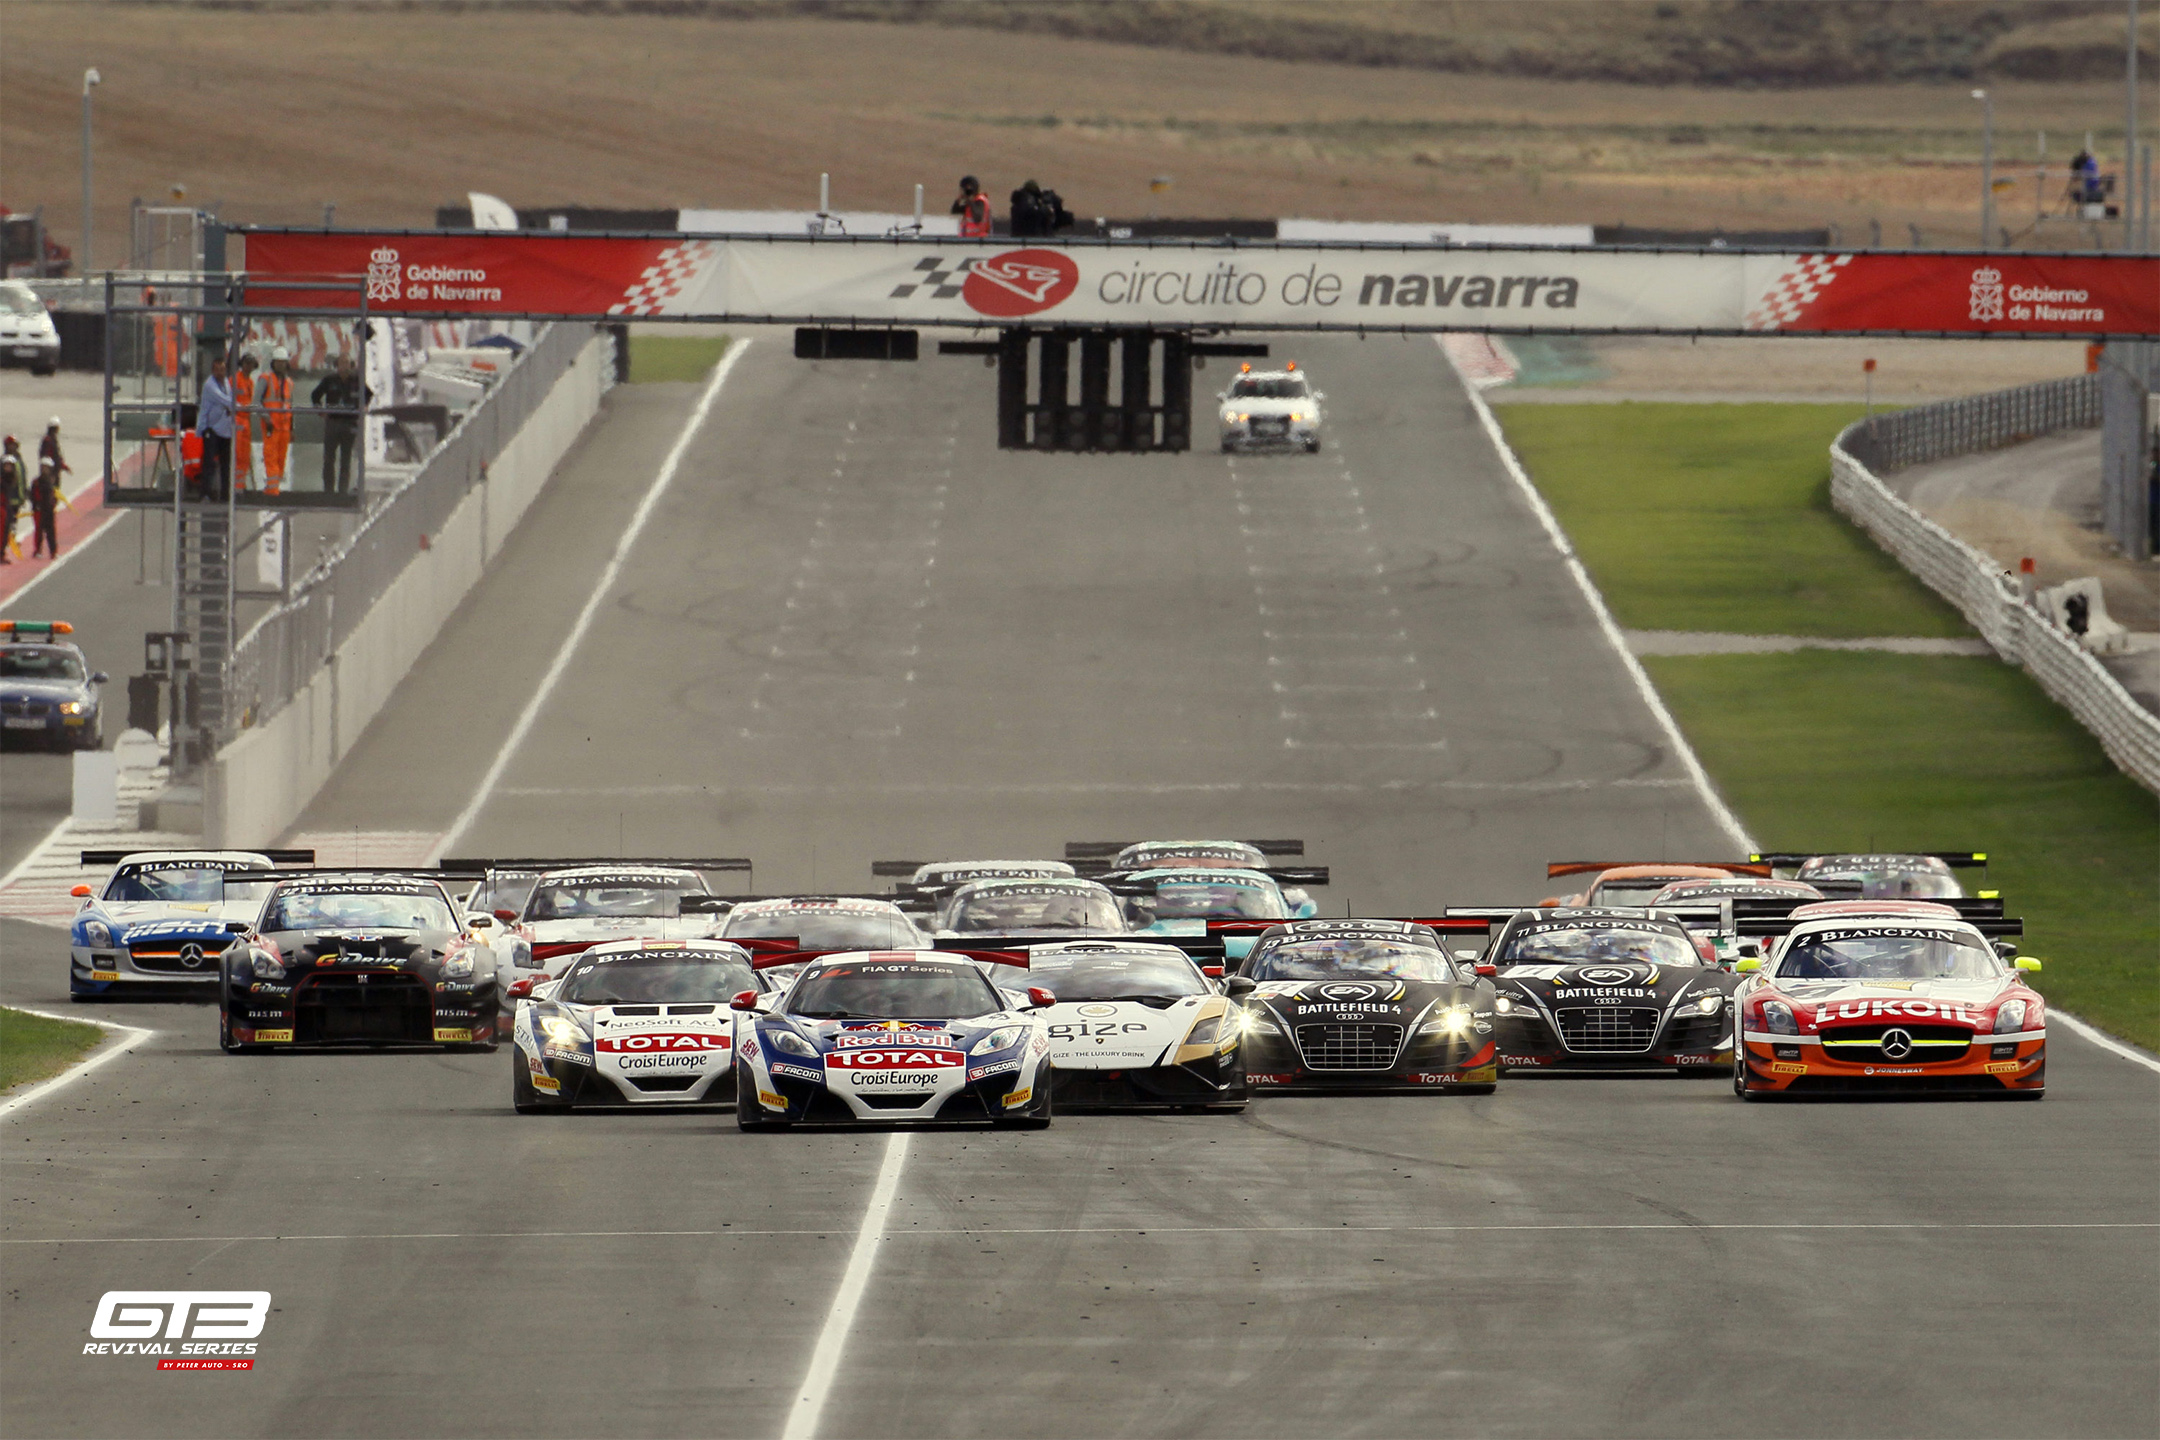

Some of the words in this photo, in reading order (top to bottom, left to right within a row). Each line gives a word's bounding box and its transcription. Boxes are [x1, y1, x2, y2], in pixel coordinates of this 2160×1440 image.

[406, 264, 486, 282] Gobierno
[1098, 260, 1267, 306] circuito
[1281, 263, 1342, 307] de
[1359, 273, 1578, 309] navarra
[406, 284, 429, 300] de
[432, 284, 502, 301] Navarra
[2009, 285, 2088, 303] Gobierno
[2008, 305, 2031, 321] de
[2035, 305, 2105, 322] Navarra
[1137, 851, 1245, 862] BLANCPAIN
[140, 861, 249, 873] BLANCPAIN
[1822, 864, 1933, 874] BLANCPAIN
[292, 877, 425, 887] NISSAN
[562, 875, 680, 886] BLANCPAIN
[941, 869, 1055, 883] BLANCPAIN
[1156, 876, 1265, 889] ANCPAIN
[300, 885, 420, 893] BLANCPAIN
[973, 885, 1092, 898] BLANCPAIN
[1681, 887, 1800, 898] BLANCPAIN
[1516, 927, 1530, 938] 77
[1535, 921, 1663, 933] BLANCPAIN
[1281, 932, 1414, 944] BLANCPAIN
[1820, 928, 1955, 942] BLANCPAIN
[1798, 936, 1811, 948] 2
[597, 951, 733, 964] BLANCPAIN
[576, 965, 595, 976] 10
[807, 970, 821, 980] 9
[910, 966, 954, 974] Series
[1586, 969, 1627, 978] EA
[1327, 985, 1370, 996] EA
[1556, 988, 1644, 999] BATTLEFIELD
[1646, 989, 1657, 999] 4
[1298, 1002, 1389, 1015] BATTLEFIELD
[1391, 1002, 1402, 1015] 4
[1815, 1000, 1977, 1025] LUKOIL
[610, 1018, 682, 1029] NeoSoft
[689, 1020, 717, 1028] AG
[257, 1031, 292, 1041] PIRELLI
[437, 1030, 470, 1040] PIRELLI
[1048, 1019, 1148, 1043] gize
[604, 1036, 723, 1050] TOTAL
[837, 1033, 895, 1049] Red
[896, 1032, 952, 1048] Bull
[743, 1038, 760, 1058] SEW
[556, 1051, 592, 1064] FACOM
[618, 1053, 708, 1070] CroisiEurope
[833, 1051, 957, 1066] TOTAL
[1500, 1054, 1541, 1066] TOTAL
[1674, 1054, 1711, 1065] TOTAL
[784, 1067, 821, 1080] FACOM
[984, 1060, 1018, 1075] FACOM
[1774, 1063, 1805, 1073] PIRELLI
[1987, 1063, 2018, 1073] PIRELLI
[851, 1071, 939, 1088] CroisiEurope
[1246, 1074, 1279, 1084] OTAL
[1419, 1073, 1458, 1084] TOTAL
[1004, 1088, 1030, 1105] PIRELLI
